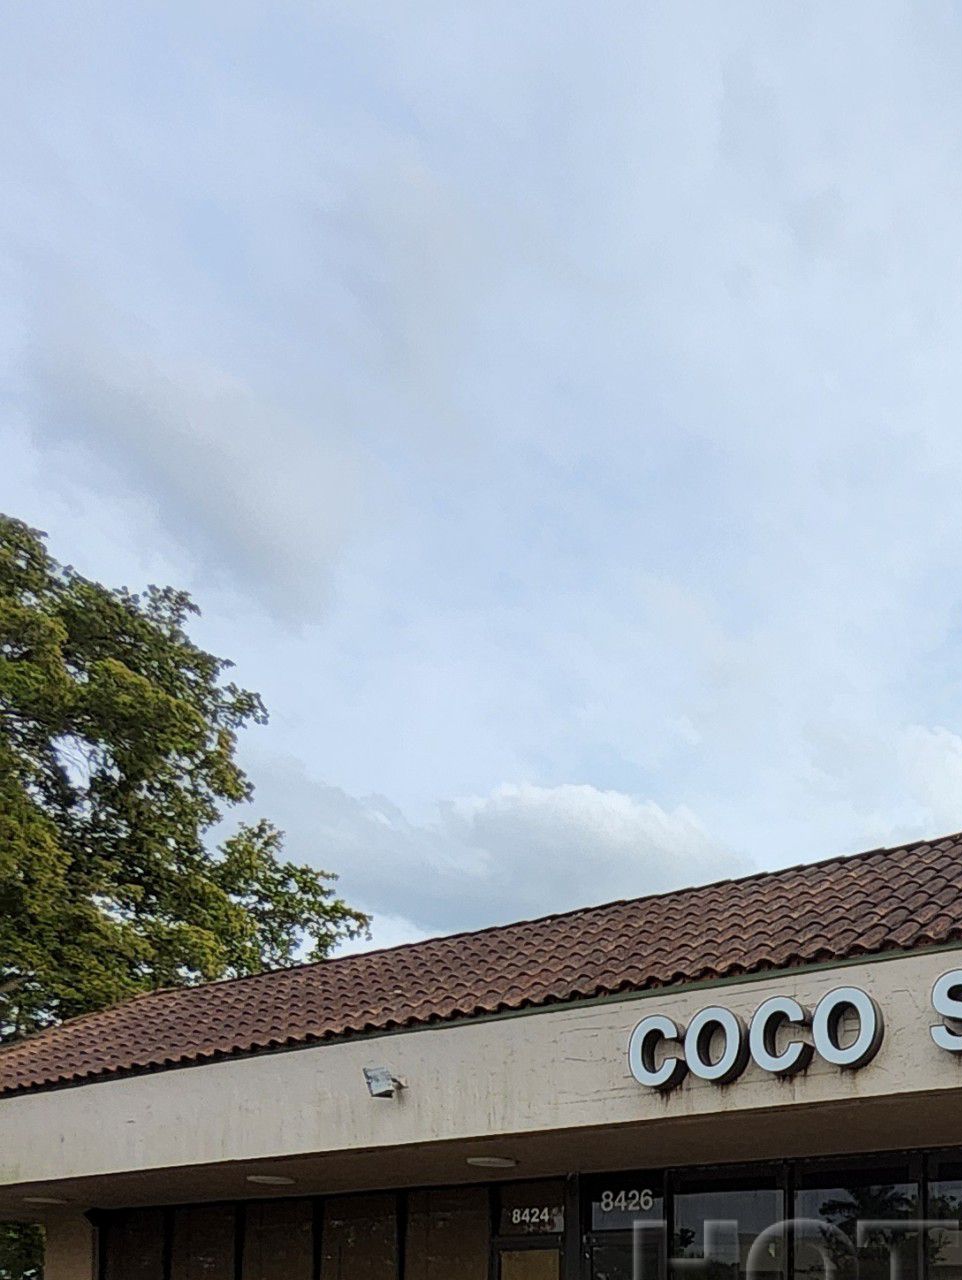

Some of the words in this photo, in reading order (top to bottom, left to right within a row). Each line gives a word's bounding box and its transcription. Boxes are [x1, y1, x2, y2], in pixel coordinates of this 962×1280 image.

[628, 986, 881, 1088] COCO
[601, 1189, 653, 1212] 8426
[512, 1207, 550, 1224] 8424
